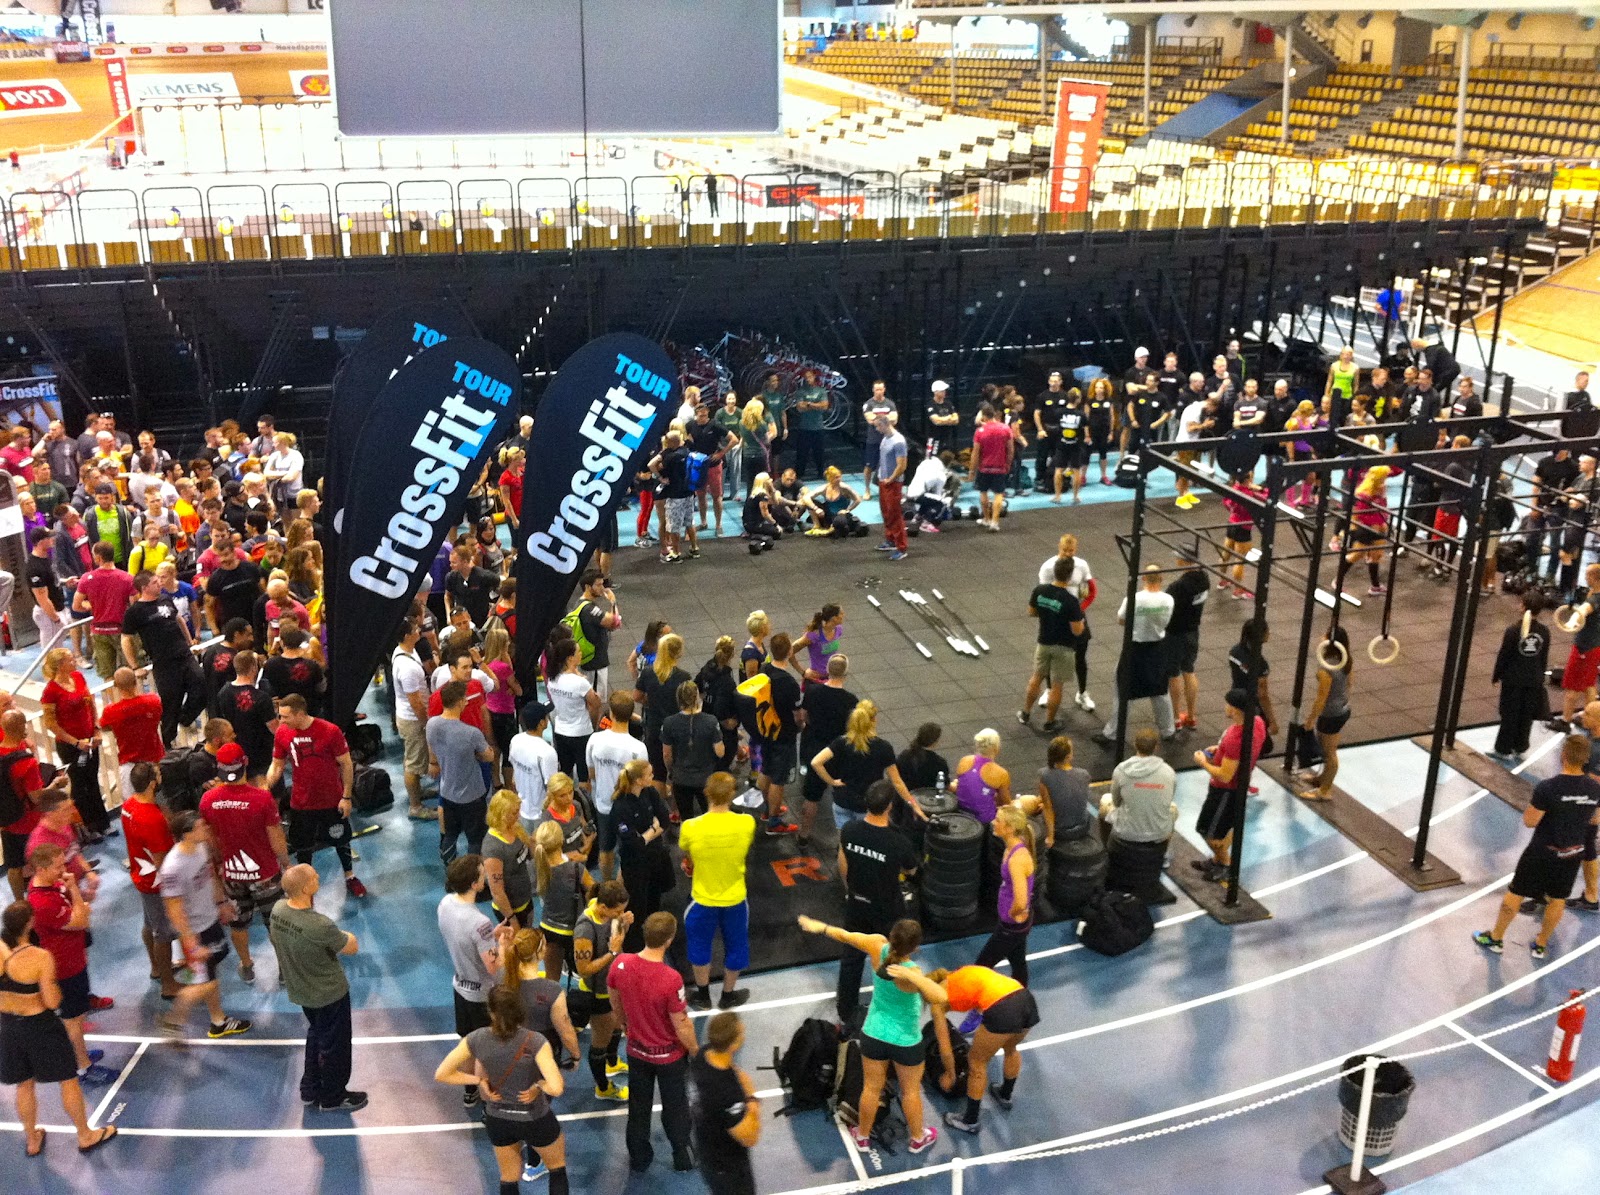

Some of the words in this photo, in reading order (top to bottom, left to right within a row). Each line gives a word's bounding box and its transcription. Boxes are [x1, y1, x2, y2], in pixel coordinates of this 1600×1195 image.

[2, 382, 57, 400] CrossFit
[450, 361, 512, 406] TOUR
[613, 353, 671, 401] TOUR
[350, 392, 498, 600] CrossFit
[527, 384, 657, 575] CrossFit
[846, 842, 887, 862] J.FLANK
[225, 870, 261, 880] PRIMAL
